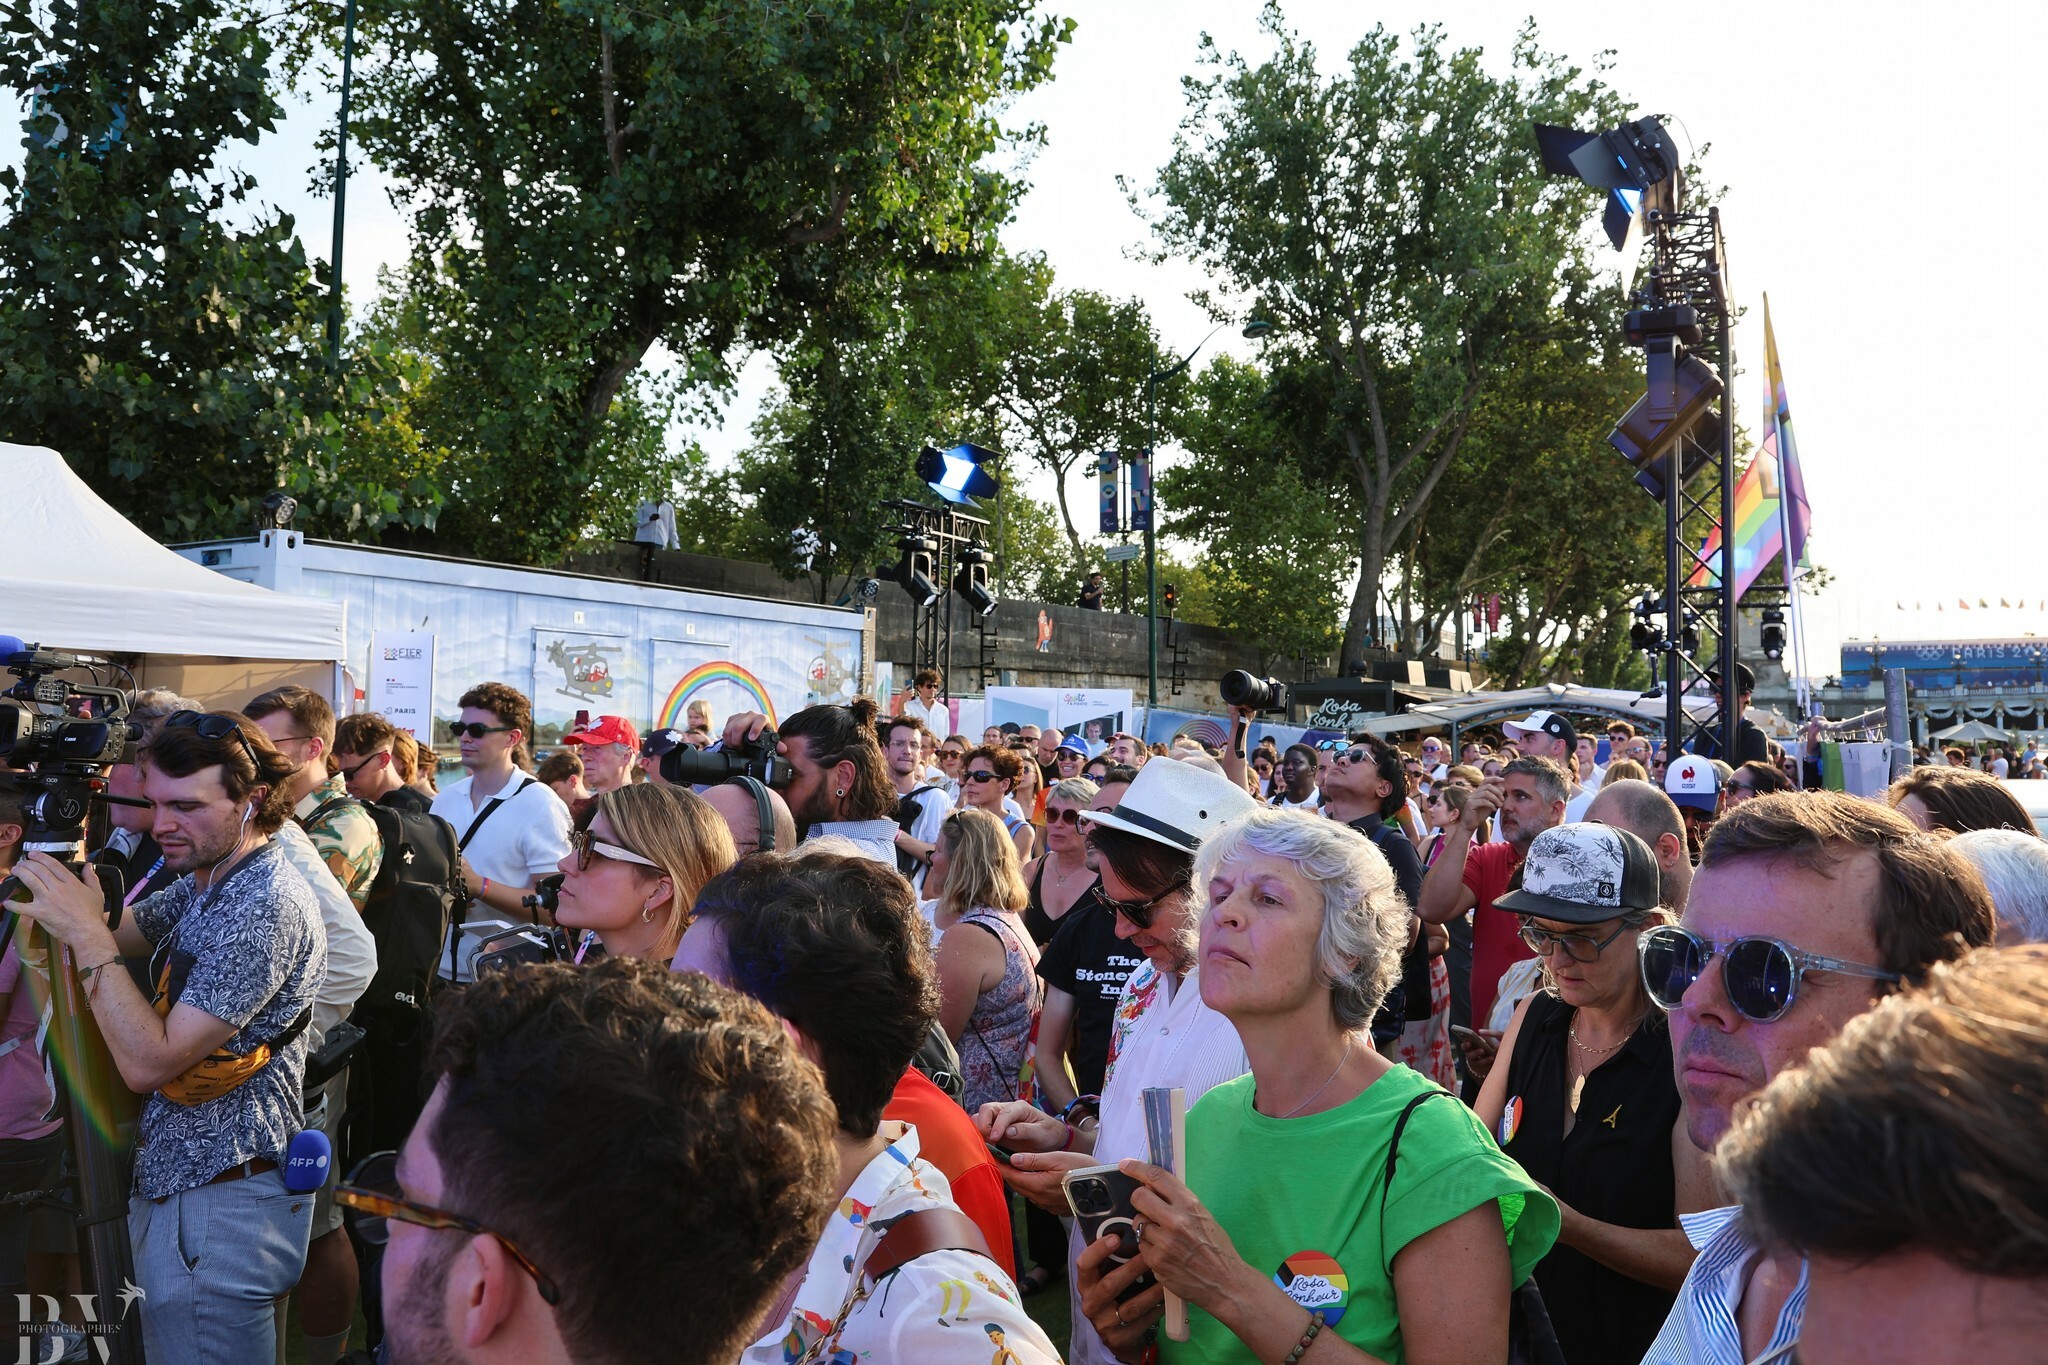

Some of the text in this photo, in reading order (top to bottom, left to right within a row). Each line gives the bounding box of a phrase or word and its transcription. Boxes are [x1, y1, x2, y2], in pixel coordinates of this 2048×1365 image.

[398, 648, 422, 657] FIER
[1952, 647, 2005, 659] PARIS
[1319, 698, 1362, 715] Rosa
[1107, 955, 1141, 967] The
[1075, 968, 1131, 982] Stone
[288, 1157, 314, 1168] AFP
[1293, 1277, 1327, 1291] Rosa
